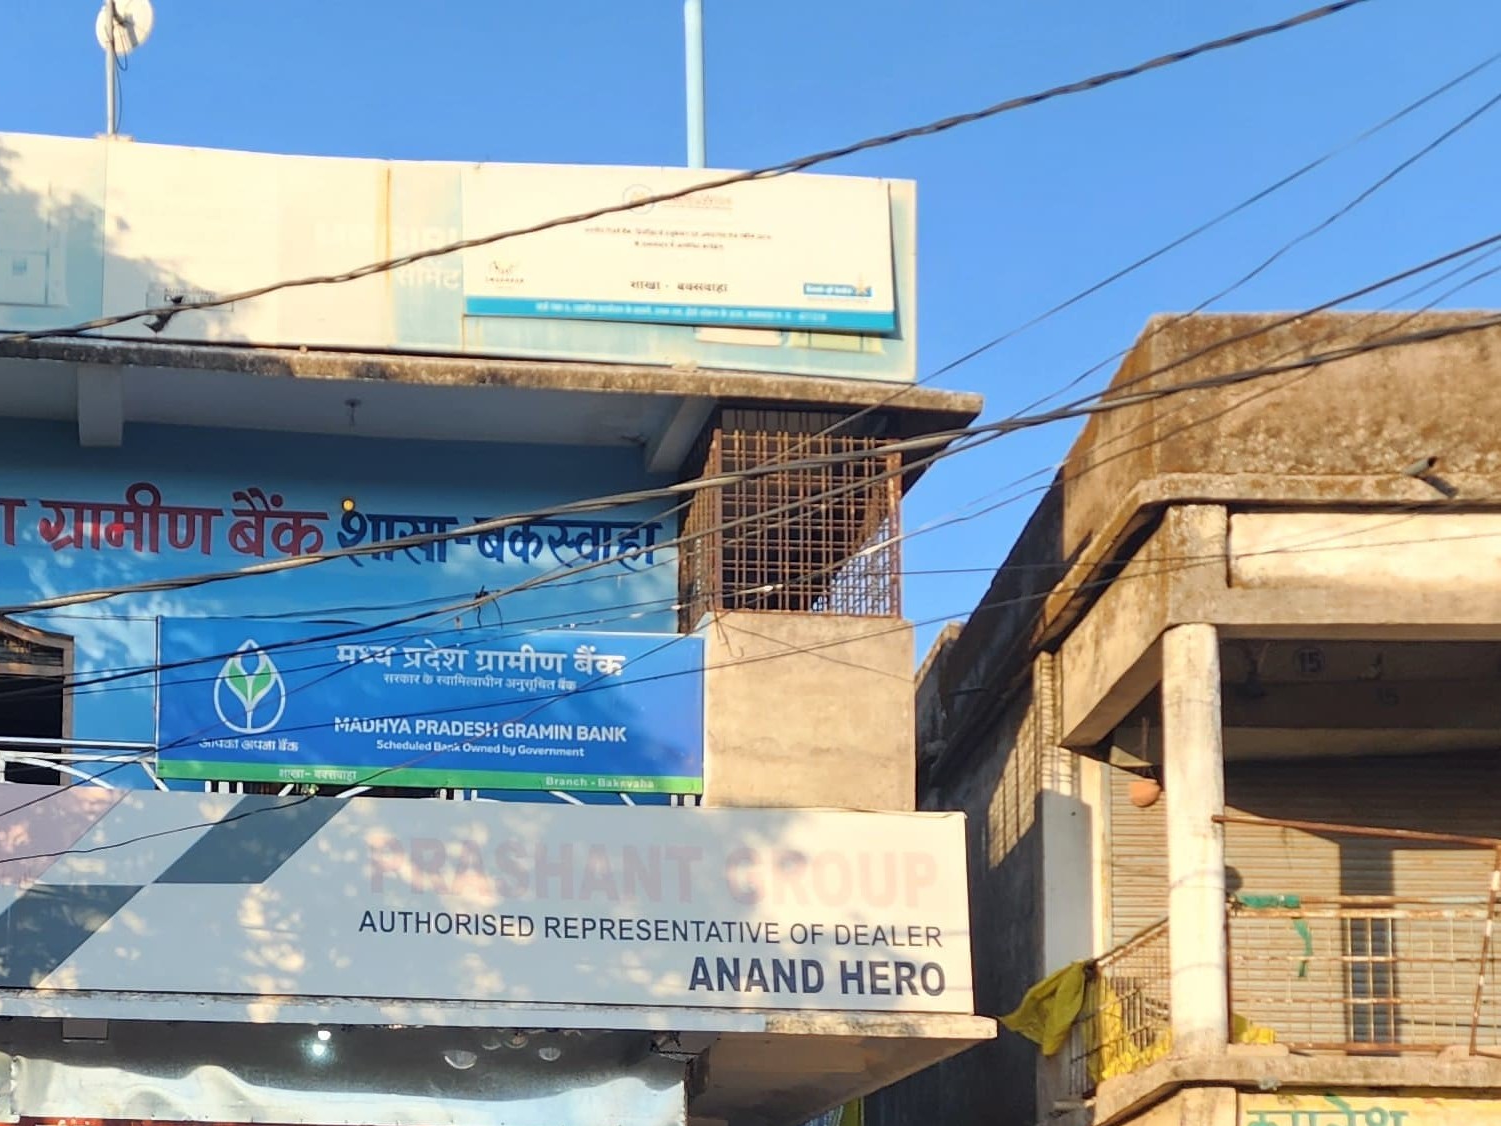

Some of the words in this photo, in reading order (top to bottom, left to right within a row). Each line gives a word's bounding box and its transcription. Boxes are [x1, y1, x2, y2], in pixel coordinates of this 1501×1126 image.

[39, 482, 223, 555] ग्रामीण
[228, 487, 330, 557] बैंक
[336, 644, 396, 667] मध्य
[475, 643, 567, 674] ग्रामीण
[573, 645, 626, 676] बैंक
[334, 717, 411, 734] MADHYA
[415, 720, 499, 738] PRADESH
[502, 723, 573, 741] GRAMIN
[576, 725, 627, 743] BANK
[376, 739, 432, 752] Scheduled
[433, 741, 460, 752] Bank
[463, 742, 500, 754] Owned
[502, 744, 516, 757] by
[518, 745, 585, 758] Government
[545, 776, 587, 786] Branch
[371, 837, 705, 901] PRASHANT
[726, 847, 937, 908] GROUP
[359, 909, 535, 938] AUTHORISED
[545, 917, 780, 945] REPRESENTATIVE
[790, 922, 824, 946] OF
[835, 924, 944, 948] DEALER
[689, 956, 825, 994] ANAND
[840, 960, 946, 997] HERO
